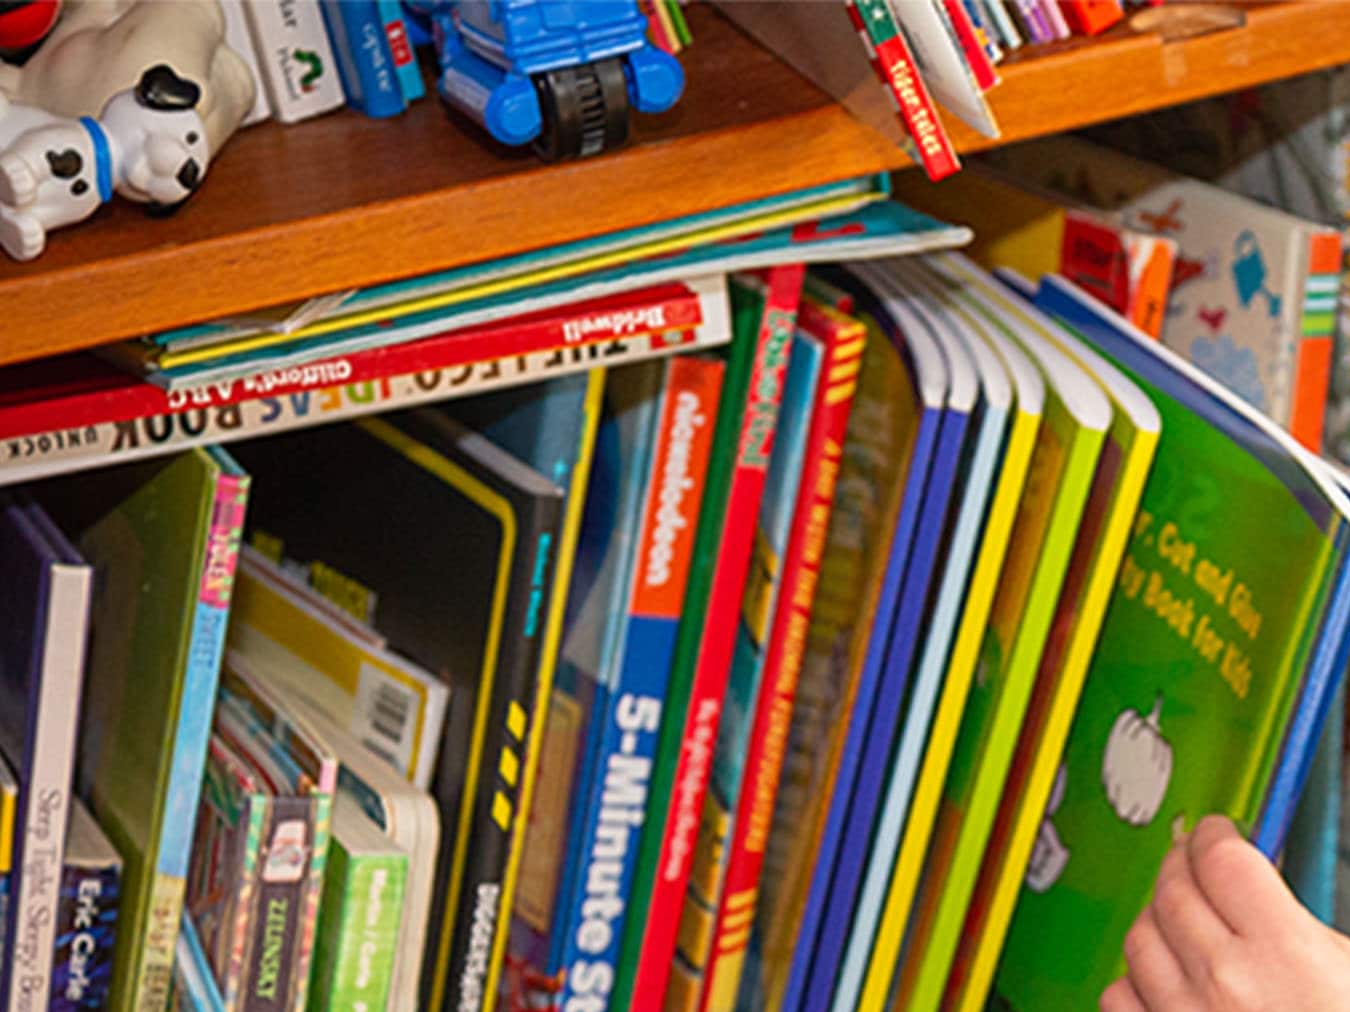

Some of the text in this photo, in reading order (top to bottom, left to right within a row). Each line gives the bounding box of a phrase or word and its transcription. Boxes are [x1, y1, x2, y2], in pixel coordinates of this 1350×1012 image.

[887, 59, 943, 157] tiger tales
[562, 304, 666, 343] Bridwell
[241, 358, 352, 395] Clifford's
[5, 424, 99, 461] UNLOCK
[106, 401, 244, 453] BOOK
[644, 389, 706, 591] nickelodeon
[800, 501, 830, 565] WITH
[792, 566, 817, 608] THE
[29, 784, 58, 843] Sleep
[576, 690, 660, 960] 5-Minute
[72, 877, 102, 931] Eric
[63, 931, 97, 1002] Carle
[253, 897, 290, 1001] ZELINSKY
